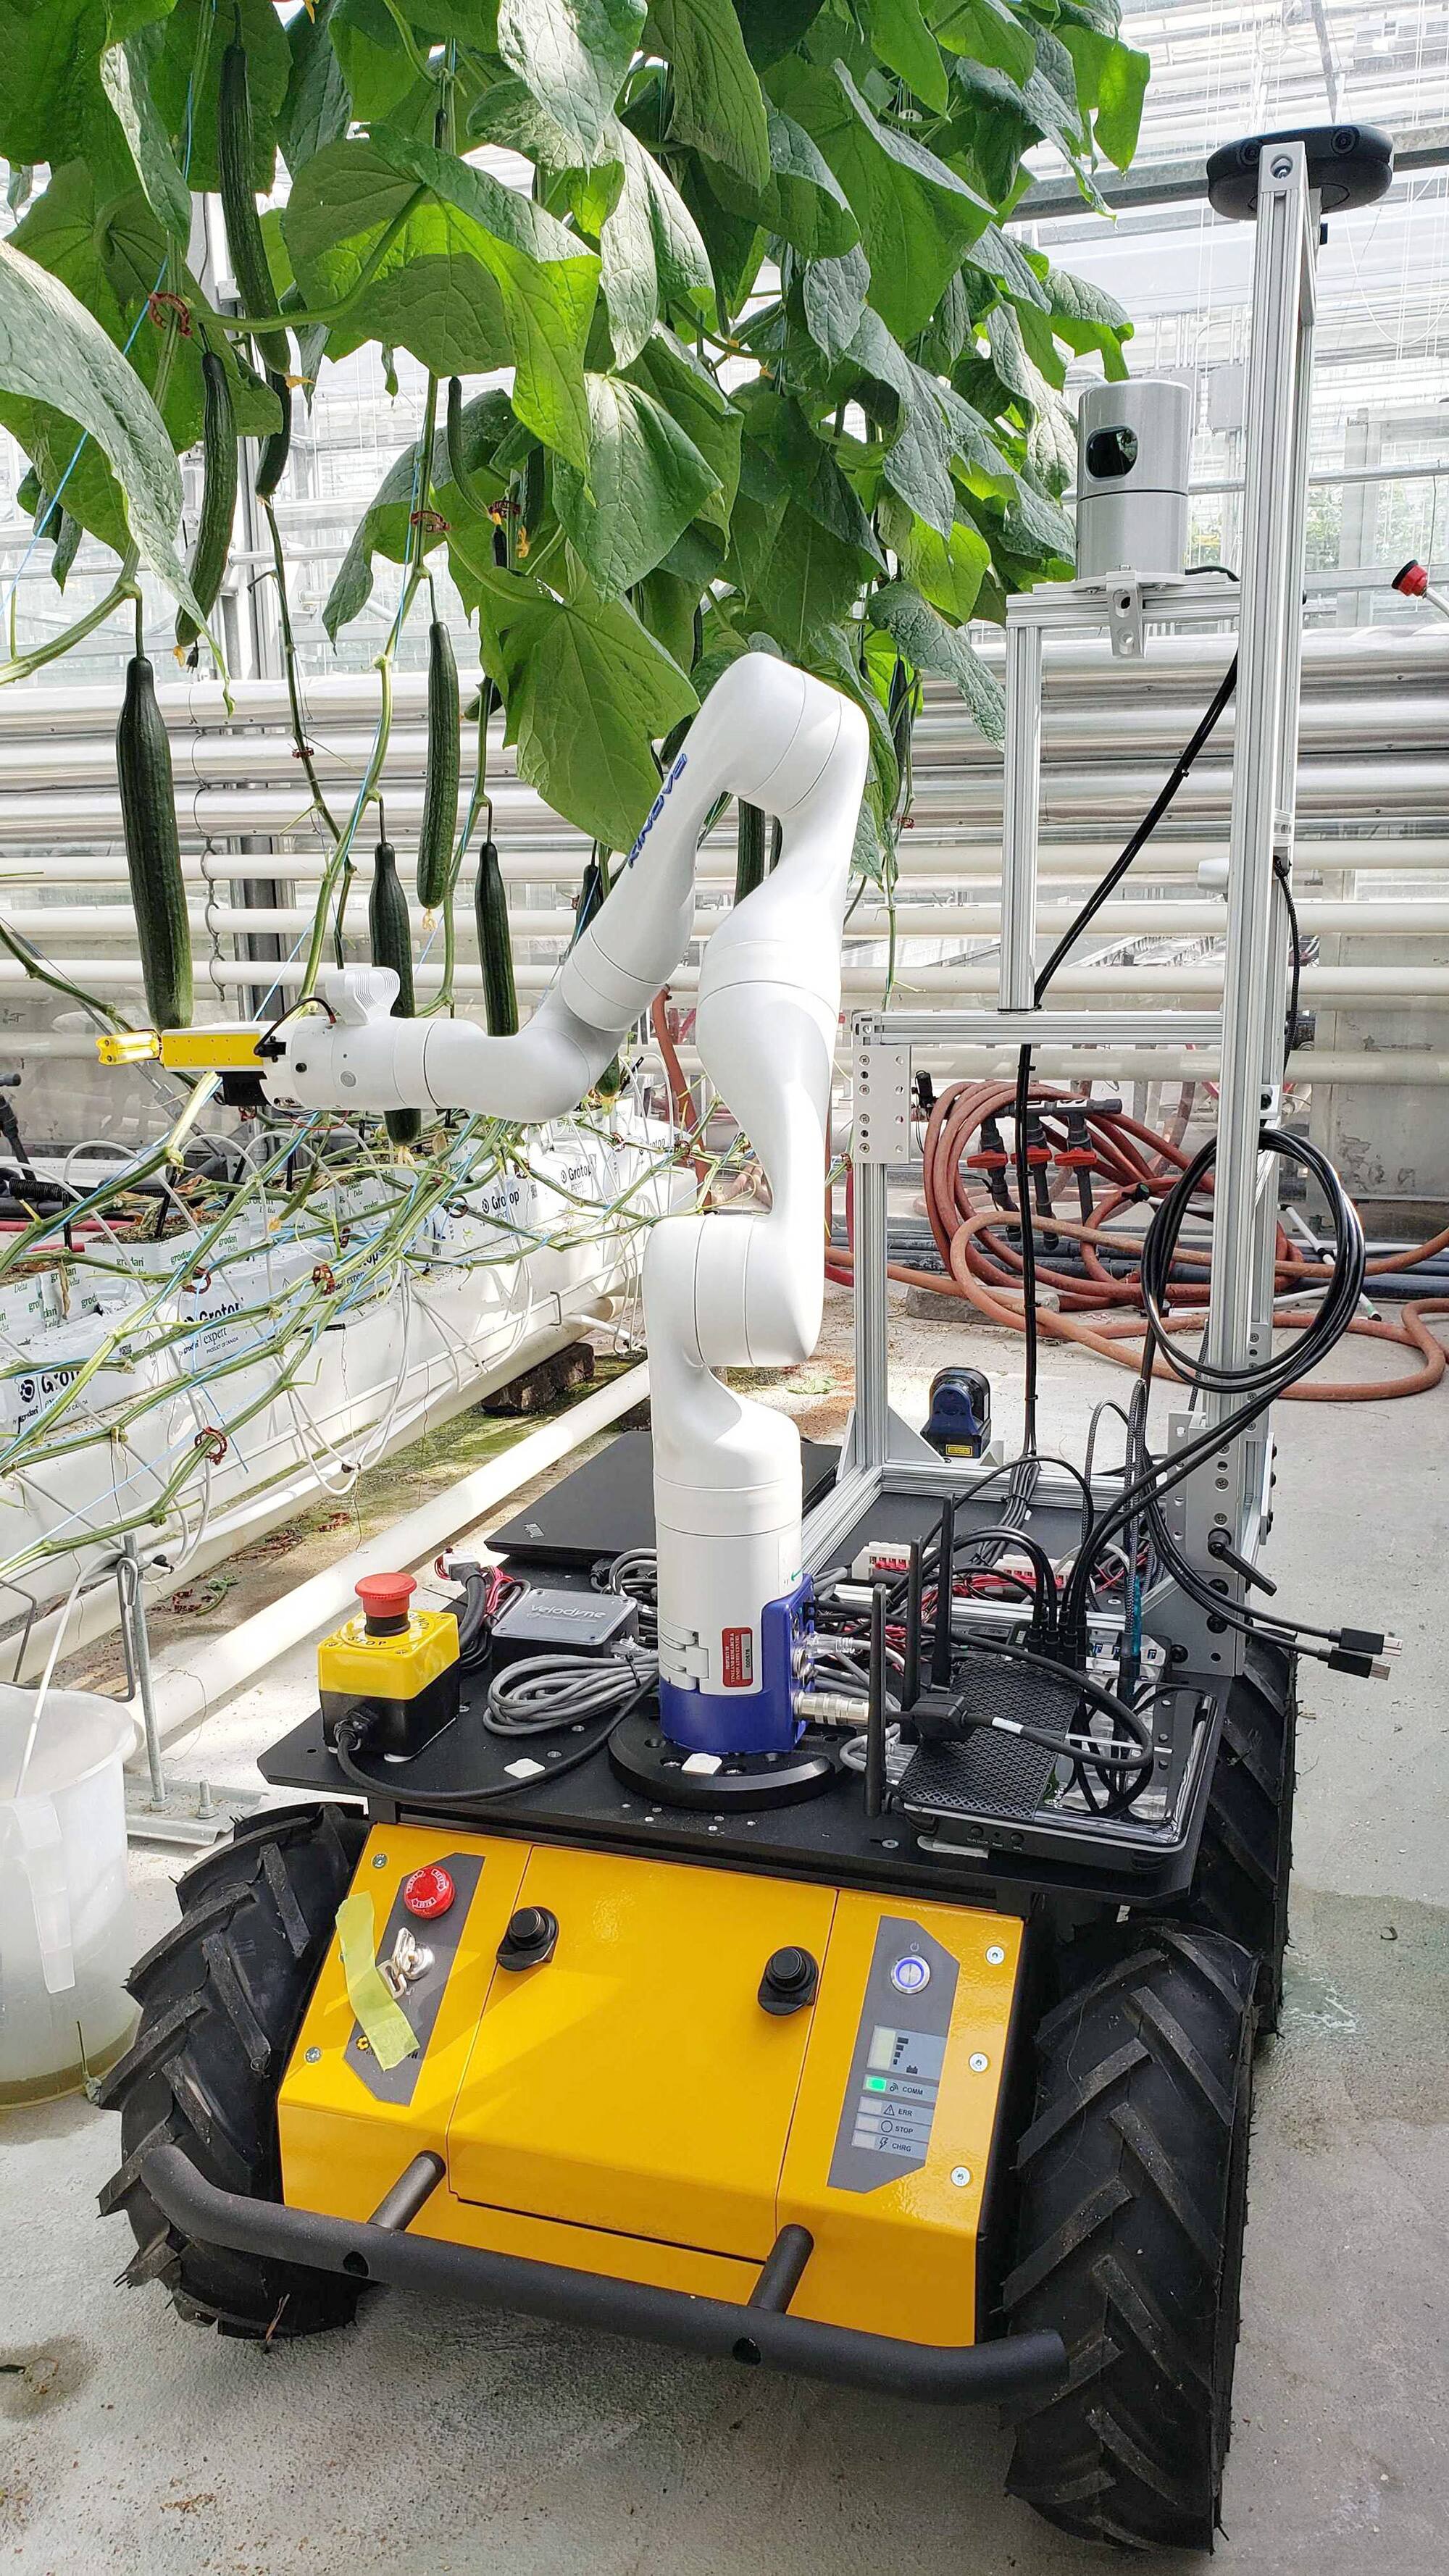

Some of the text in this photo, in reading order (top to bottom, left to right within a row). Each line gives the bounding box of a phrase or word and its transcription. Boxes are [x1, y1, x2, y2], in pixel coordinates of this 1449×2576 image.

[491, 1189, 519, 1210] Groop
[348, 1636, 387, 1646] STOP
[902, 2086, 924, 2095] COMM
[895, 2125, 914, 2134] STOP
[891, 2142, 912, 2152] CHRG
